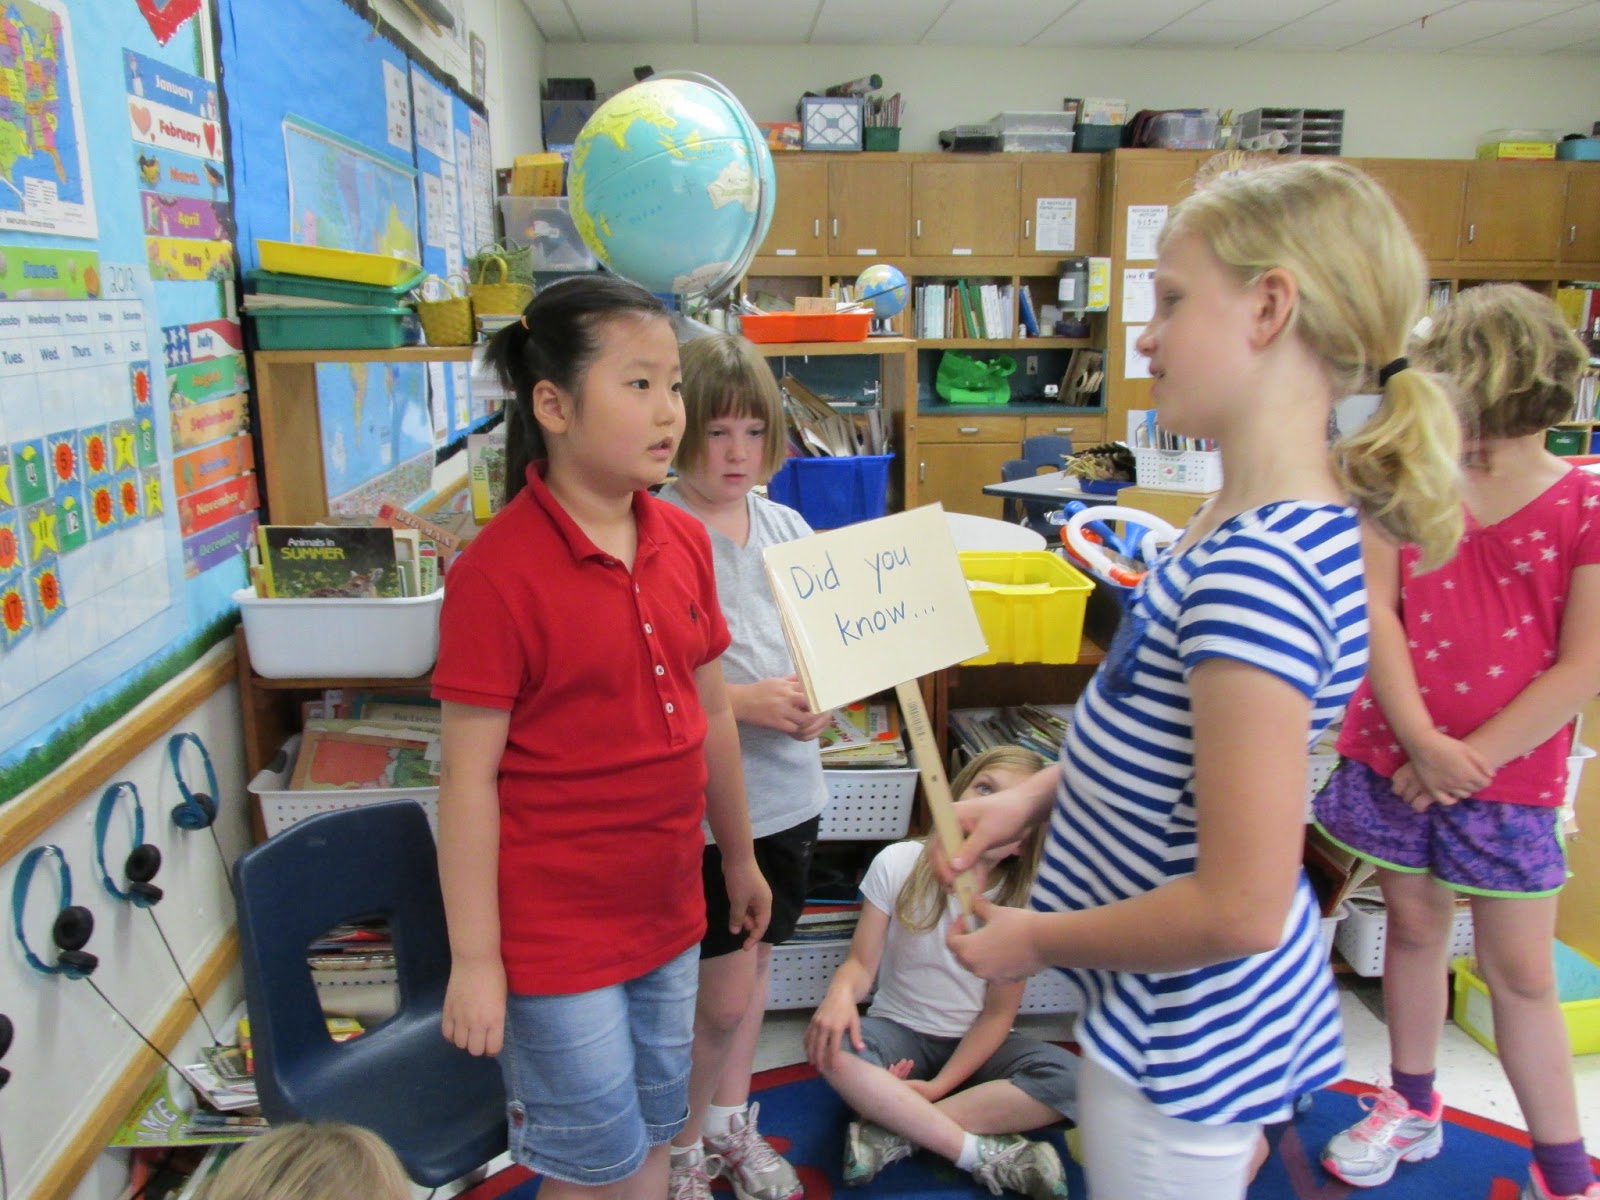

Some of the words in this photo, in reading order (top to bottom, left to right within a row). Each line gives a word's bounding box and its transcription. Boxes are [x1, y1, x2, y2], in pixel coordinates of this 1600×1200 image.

[155, 74, 194, 104] January
[159, 119, 201, 148] February
[178, 211, 201, 229] April
[183, 252, 202, 272] May
[0, 315, 21, 327] uesday
[197, 332, 214, 351] July
[287, 537, 325, 547] Animals
[326, 537, 335, 547] in
[280, 547, 346, 560] SUMMER
[789, 550, 840, 600] Did
[863, 546, 911, 595] you
[834, 601, 935, 647] know...
